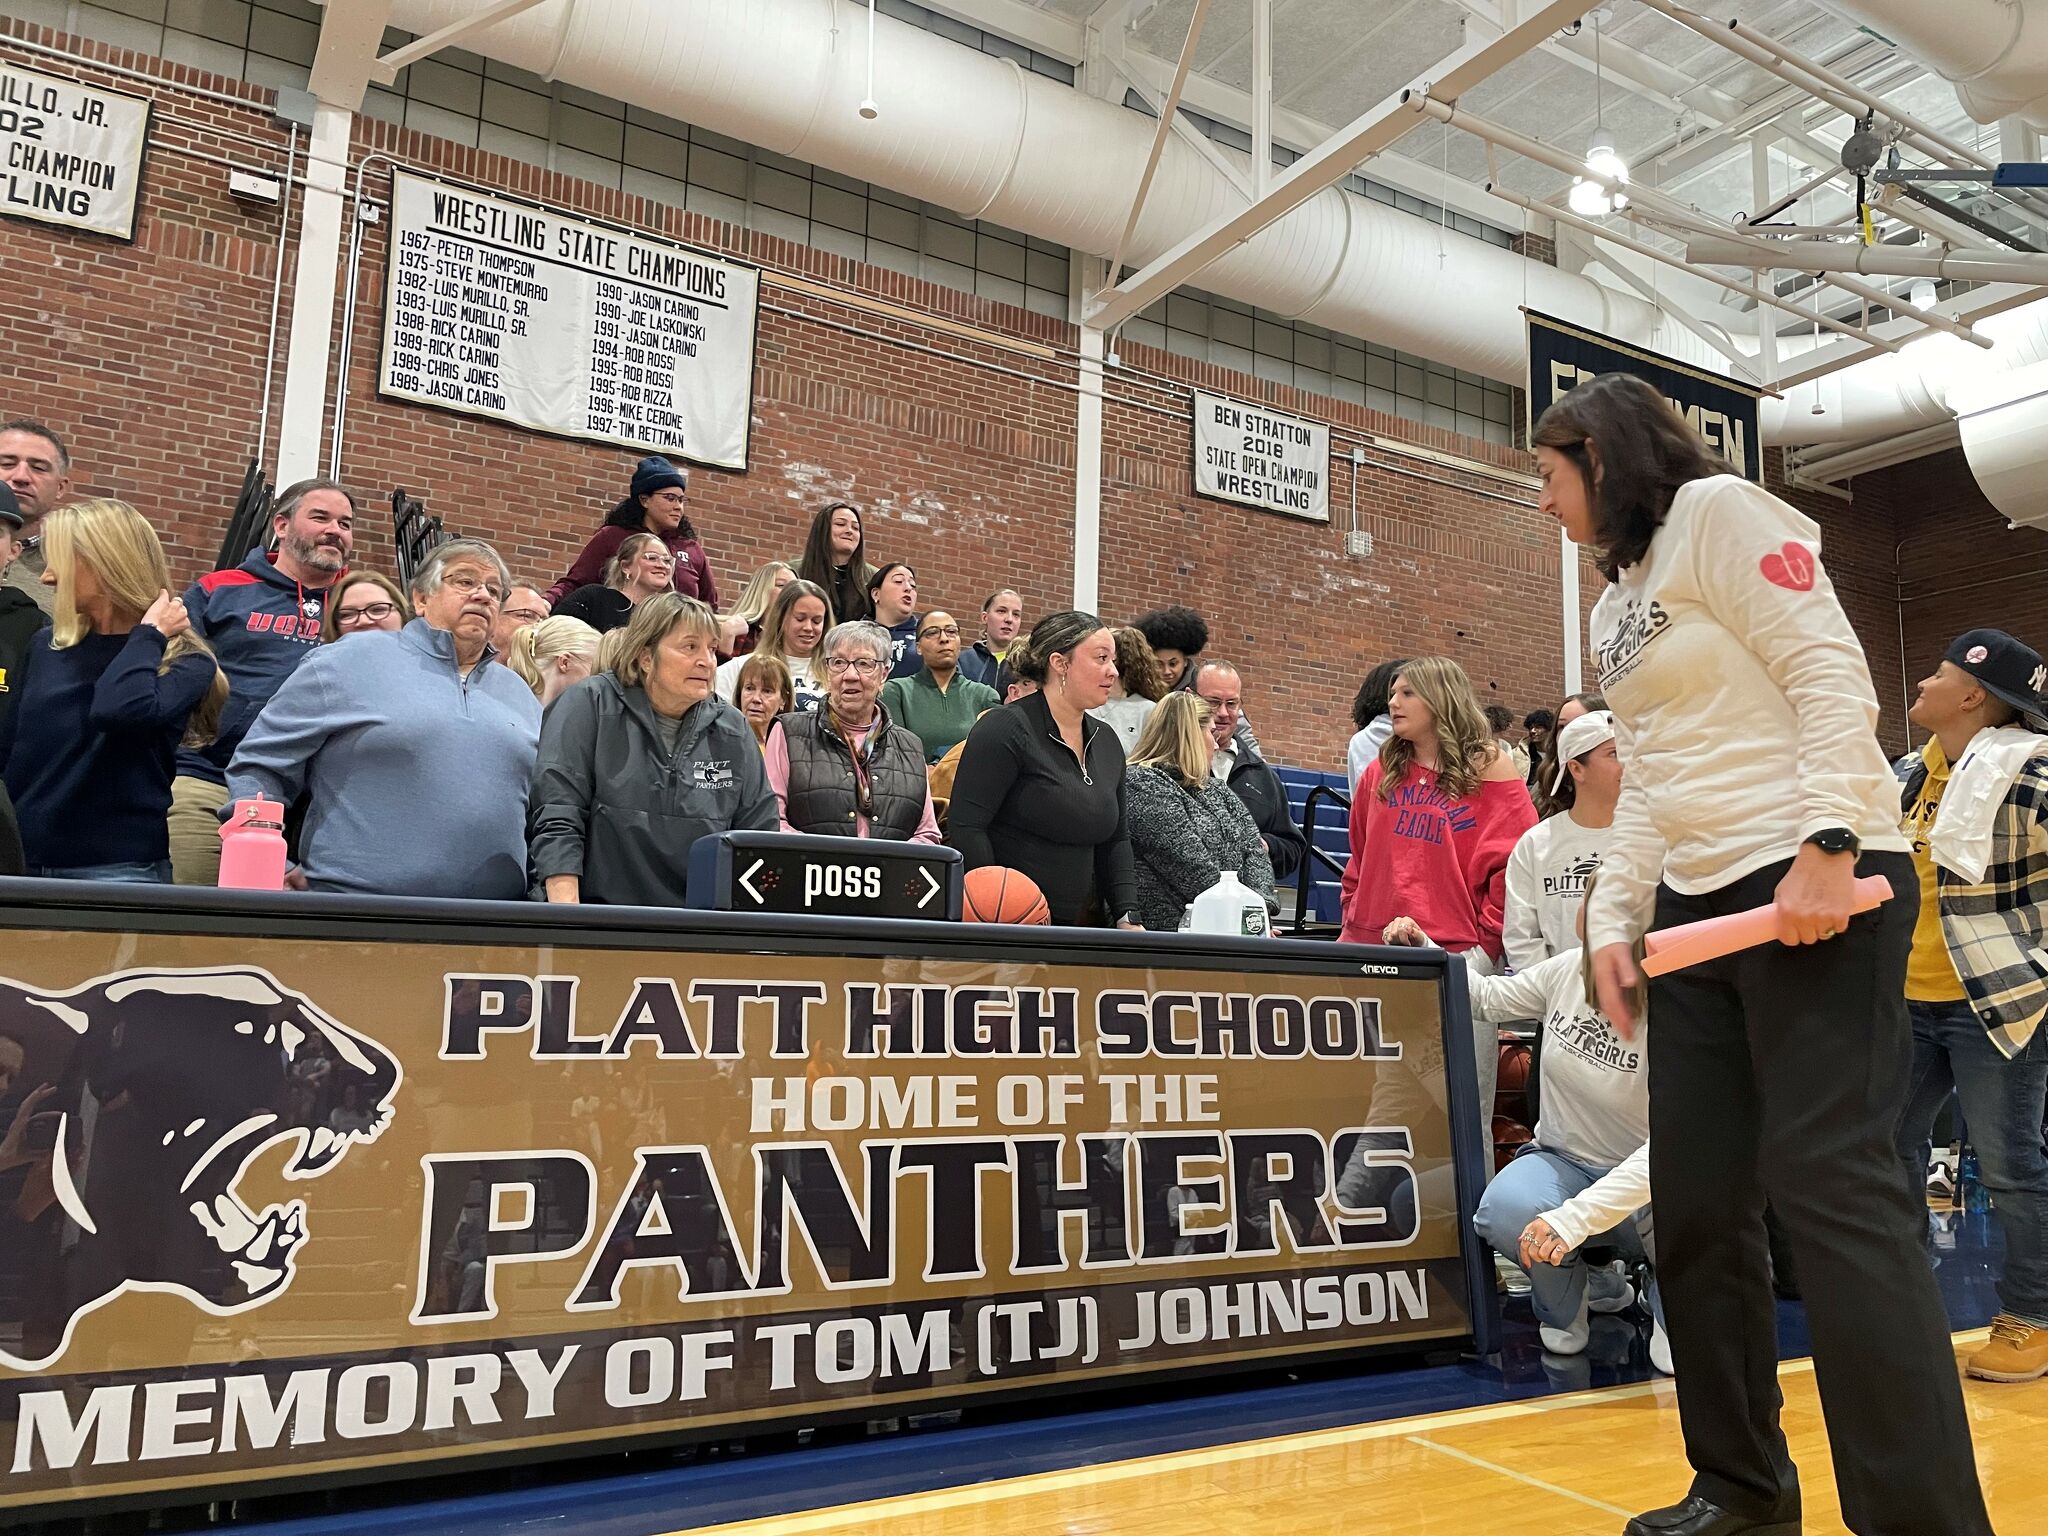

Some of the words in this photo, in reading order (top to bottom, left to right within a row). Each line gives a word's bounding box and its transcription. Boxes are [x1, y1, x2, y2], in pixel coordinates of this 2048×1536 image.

[72, 97, 109, 128] JR.
[8, 141, 116, 191] CHAMPION
[0, 173, 91, 217] LING
[400, 230, 474, 263] 1967-PETER
[478, 249, 535, 279] THOMPSON
[434, 192, 546, 251] WRESTLING
[558, 229, 618, 271] STATE
[627, 246, 727, 299] CHAMPIONS
[397, 269, 459, 299] 1982-LUIS
[462, 285, 510, 314] MURILLO,
[513, 299, 531, 318] SR.
[399, 250, 473, 283] 1975-STEVE
[477, 269, 548, 302] MONTEMURRO
[395, 289, 457, 319] 1983-LUIS
[460, 305, 508, 334] MURILLO,
[510, 319, 528, 337] SR.
[594, 300, 646, 328] 1990-JOE
[649, 314, 706, 342] LASKOWSKI
[596, 281, 661, 312] 1990-JASON
[664, 301, 699, 321] CARINO
[394, 309, 457, 340] 1988-RICK
[460, 325, 500, 349] CARINO
[593, 319, 659, 349] 1991-JASON
[661, 338, 697, 358] CARINO
[391, 350, 460, 380] 1989-CHRIS
[463, 366, 499, 389] JONES
[393, 330, 455, 360] 1989-RICK
[459, 345, 499, 369] CARINO
[592, 338, 645, 366] 1994-ROB
[647, 352, 676, 372] ROSSI
[389, 371, 463, 402] 1989-JASON
[466, 388, 506, 411] CARINO
[589, 376, 640, 401] 1995-ROB
[643, 389, 673, 409] RIZZA
[590, 357, 642, 384] 1995-ROB
[645, 370, 674, 390] ROSSI
[586, 414, 636, 440] 1997-TIM
[638, 425, 684, 449] RETTMAN
[587, 395, 643, 422] 1996-MIKE
[645, 408, 683, 431] CERONE
[1214, 404, 1240, 429] BEN
[1245, 413, 1311, 447] STRATTON
[1243, 435, 1283, 459] 2018
[1206, 445, 1237, 471] STATE
[1242, 454, 1267, 477] OPEN
[1271, 461, 1319, 490] CHAMPION
[1217, 470, 1310, 510] WRESTLING
[693, 760, 731, 769] PLATT
[695, 780, 733, 790] PANTHERS
[1389, 784, 1477, 833] AMERICAN
[1393, 809, 1447, 845] EAGLE
[438, 972, 827, 1060] PLATT
[842, 981, 1079, 1060] HIGH
[1096, 988, 1403, 1061] SCHOOL
[1549, 1010, 1586, 1045] PLATT
[1595, 1040, 1639, 1069] GIRLS
[1558, 1041, 1607, 1072] BASKETBALL
[749, 1075, 979, 1133] HOME
[996, 1073, 1086, 1127] OF
[1099, 1073, 1221, 1124] THE
[408, 1126, 1421, 1326] PANTHERS
[9, 1344, 582, 1475] MEMORY
[604, 1330, 736, 1408] OF
[755, 1309, 953, 1391] TOM
[977, 1296, 1099, 1375] (TJ)
[1118, 1268, 1429, 1351] JOHNSON
